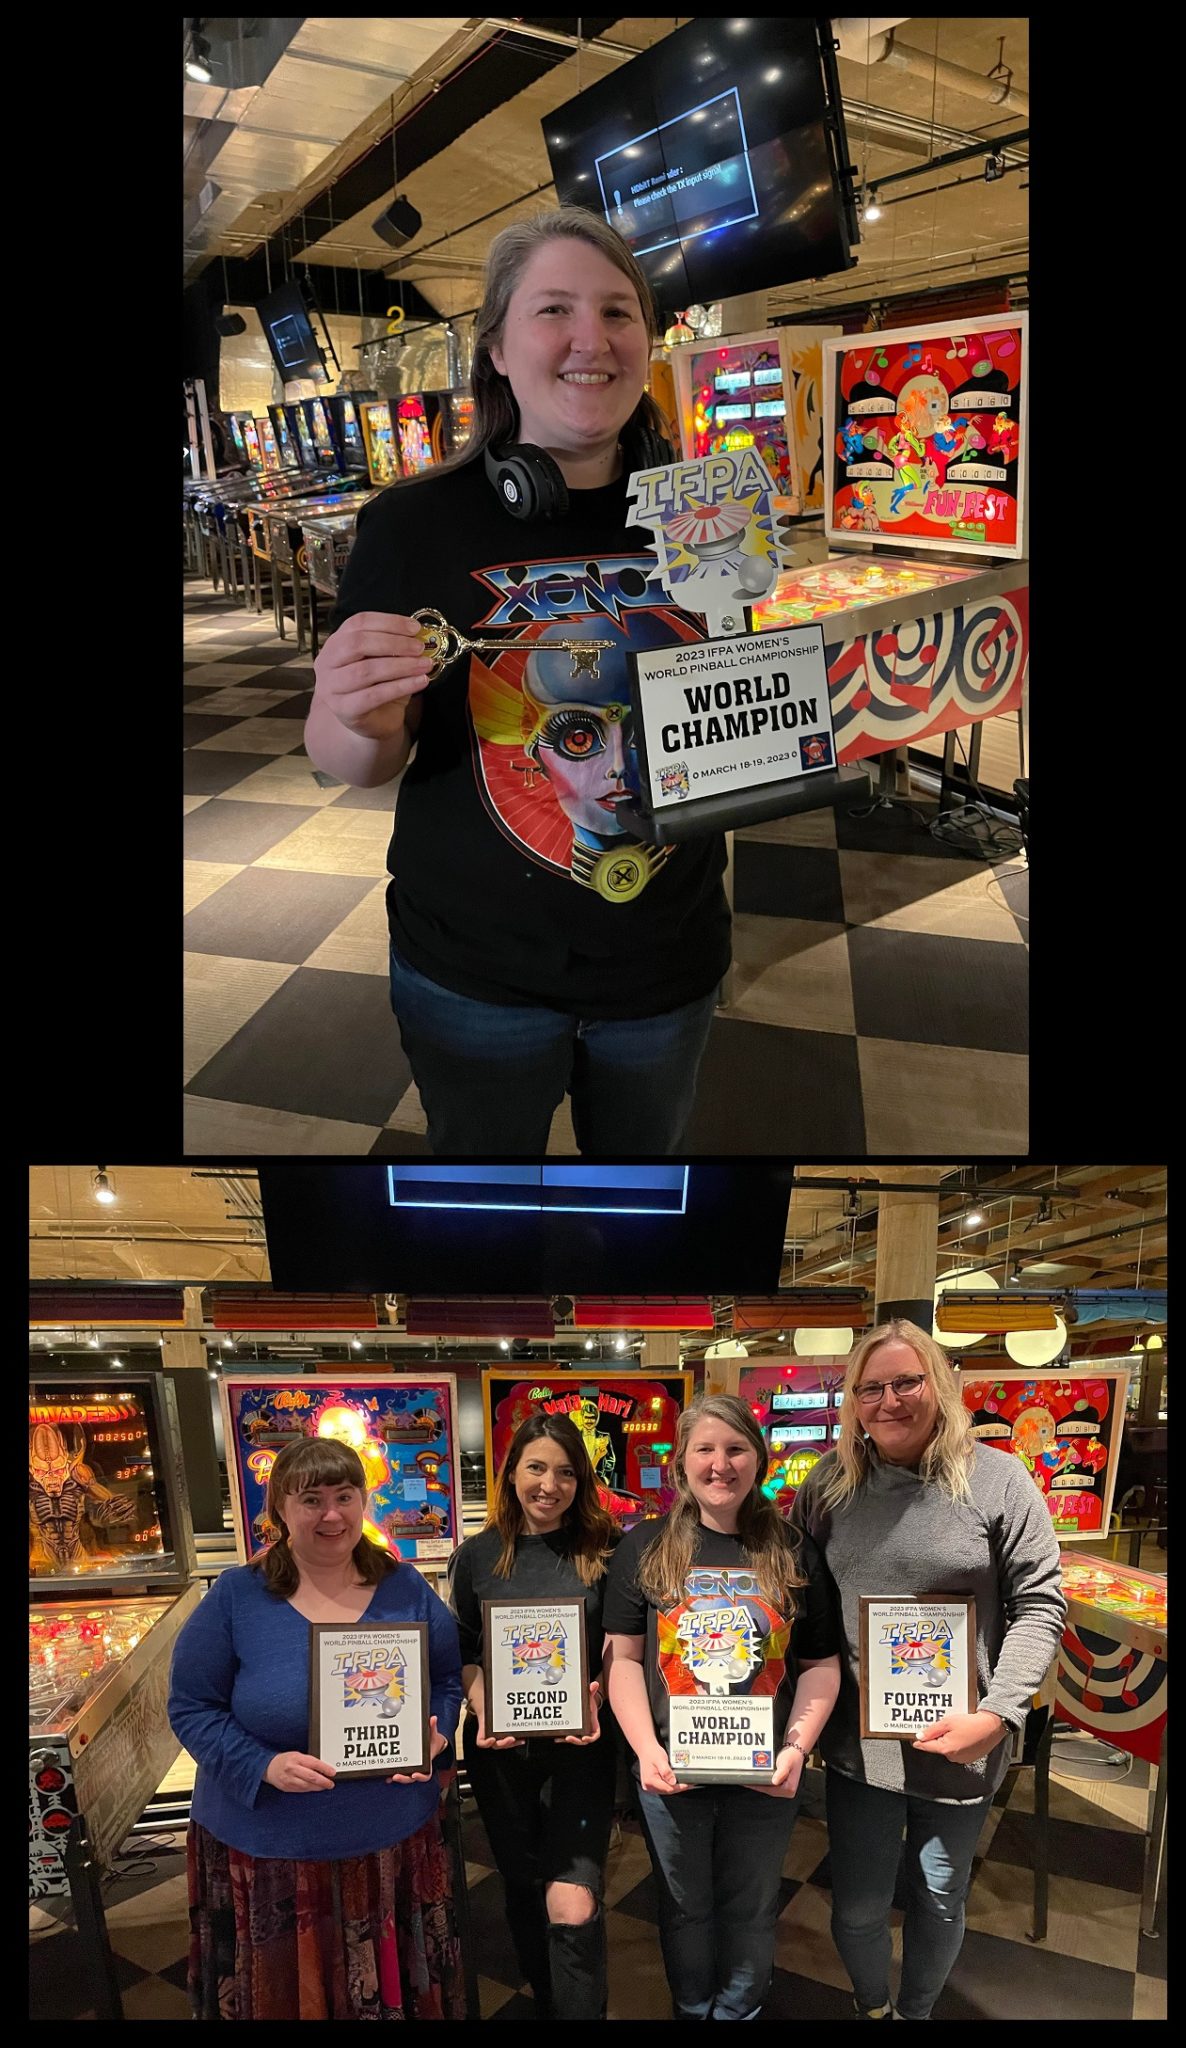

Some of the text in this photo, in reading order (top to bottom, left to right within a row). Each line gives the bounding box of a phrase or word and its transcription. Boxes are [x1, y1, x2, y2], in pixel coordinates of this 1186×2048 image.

[633, 164, 722, 208] Please check the TX input signal
[386, 305, 406, 334] 2
[635, 451, 774, 521] IFPA
[922, 489, 1009, 521] FUN-FEST
[482, 557, 676, 626] XENO
[644, 644, 820, 681] WORLD PINBALL CHAMPIONSHIP
[675, 636, 791, 664] 2023 IFPA WOMEN'S
[683, 671, 791, 715] WORLD
[660, 697, 819, 754] CHAMPION
[700, 763, 738, 778] MARCH
[739, 757, 766, 770] 18-19,
[766, 752, 790, 764] 2023
[542, 1392, 634, 1419] Mata Hari
[784, 1459, 820, 1471] TARG
[785, 1470, 809, 1486] ALP
[1046, 1494, 1096, 1517] N-FEST
[500, 1619, 568, 1647] IFPA
[679, 1608, 753, 1636] IFPA
[878, 1618, 954, 1645] IFPA
[330, 1646, 408, 1676] IFPA
[506, 1690, 568, 1705] SECOND
[883, 1692, 953, 1707] FOURTH
[512, 1706, 563, 1721] PLACE
[691, 1716, 751, 1730] WORLD
[891, 1708, 946, 1722] PLACE
[343, 1724, 400, 1742] THIRD
[677, 1731, 766, 1746] CHAMPION
[342, 1759, 367, 1767] MARCH
[343, 1740, 401, 1759] PLACE
